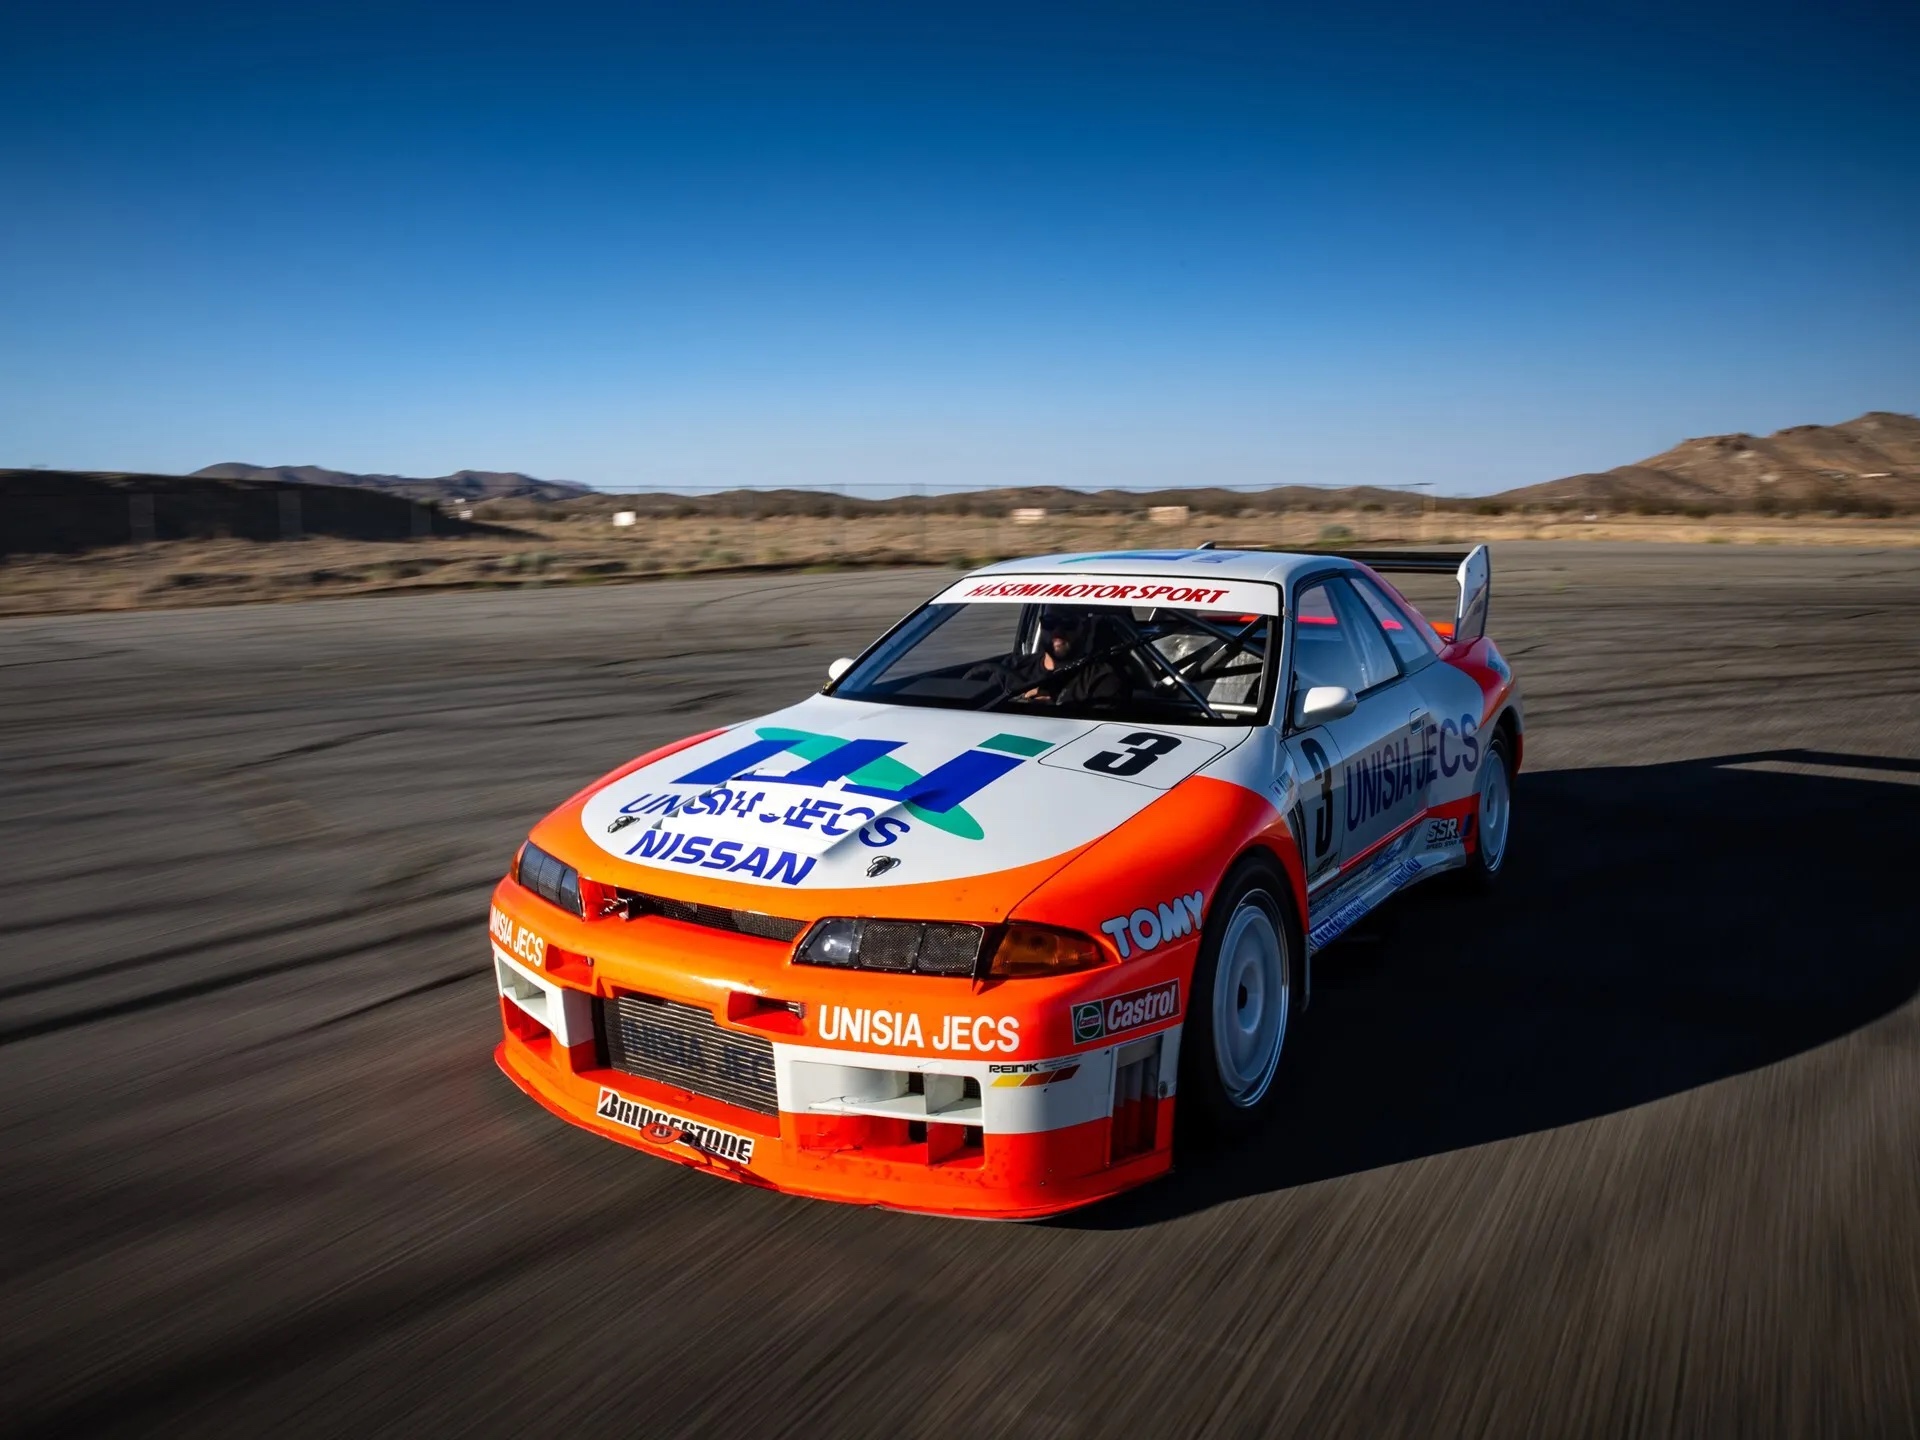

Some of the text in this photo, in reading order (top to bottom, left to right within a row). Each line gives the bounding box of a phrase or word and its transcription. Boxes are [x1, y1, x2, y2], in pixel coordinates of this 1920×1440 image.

[1083, 732, 1182, 776] 3
[1346, 713, 1479, 832] UNISIA JECS
[1300, 737, 1334, 858] 3
[1426, 817, 1459, 843] SSR
[625, 829, 818, 886] NISSAN
[513, 926, 544, 967] JECS
[1102, 890, 1204, 958] TOMY
[818, 1004, 1020, 1053] UNISIA JECS
[1107, 984, 1176, 1031] Castrol
